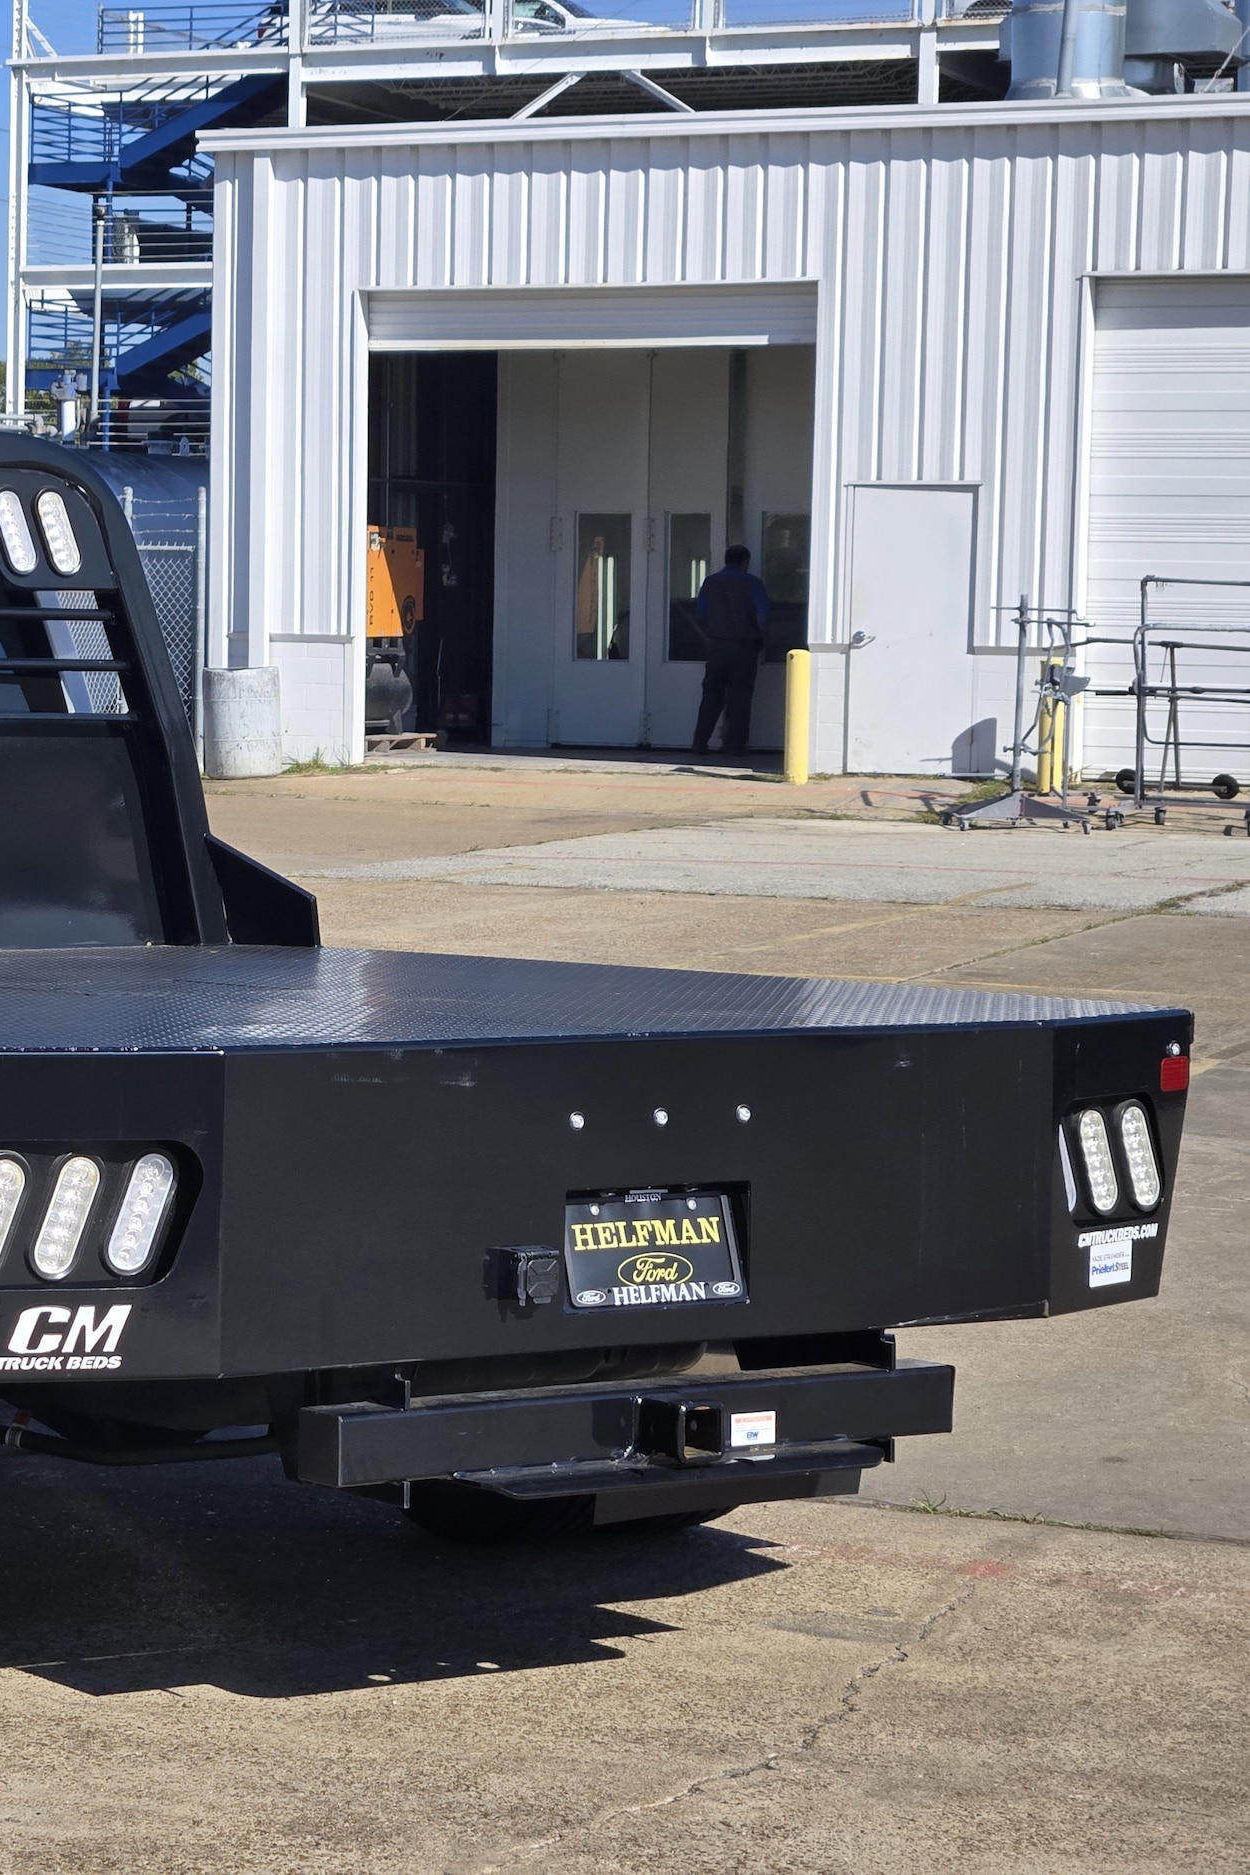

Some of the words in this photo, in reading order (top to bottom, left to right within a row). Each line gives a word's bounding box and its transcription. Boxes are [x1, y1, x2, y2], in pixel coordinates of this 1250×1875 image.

[571, 1216, 721, 1251] HELFMAN
[631, 1256, 679, 1284] Ford
[611, 1281, 707, 1307] HELFMAN
[7, 1304, 133, 1355] CM
[65, 1355, 123, 1370] BEDS
